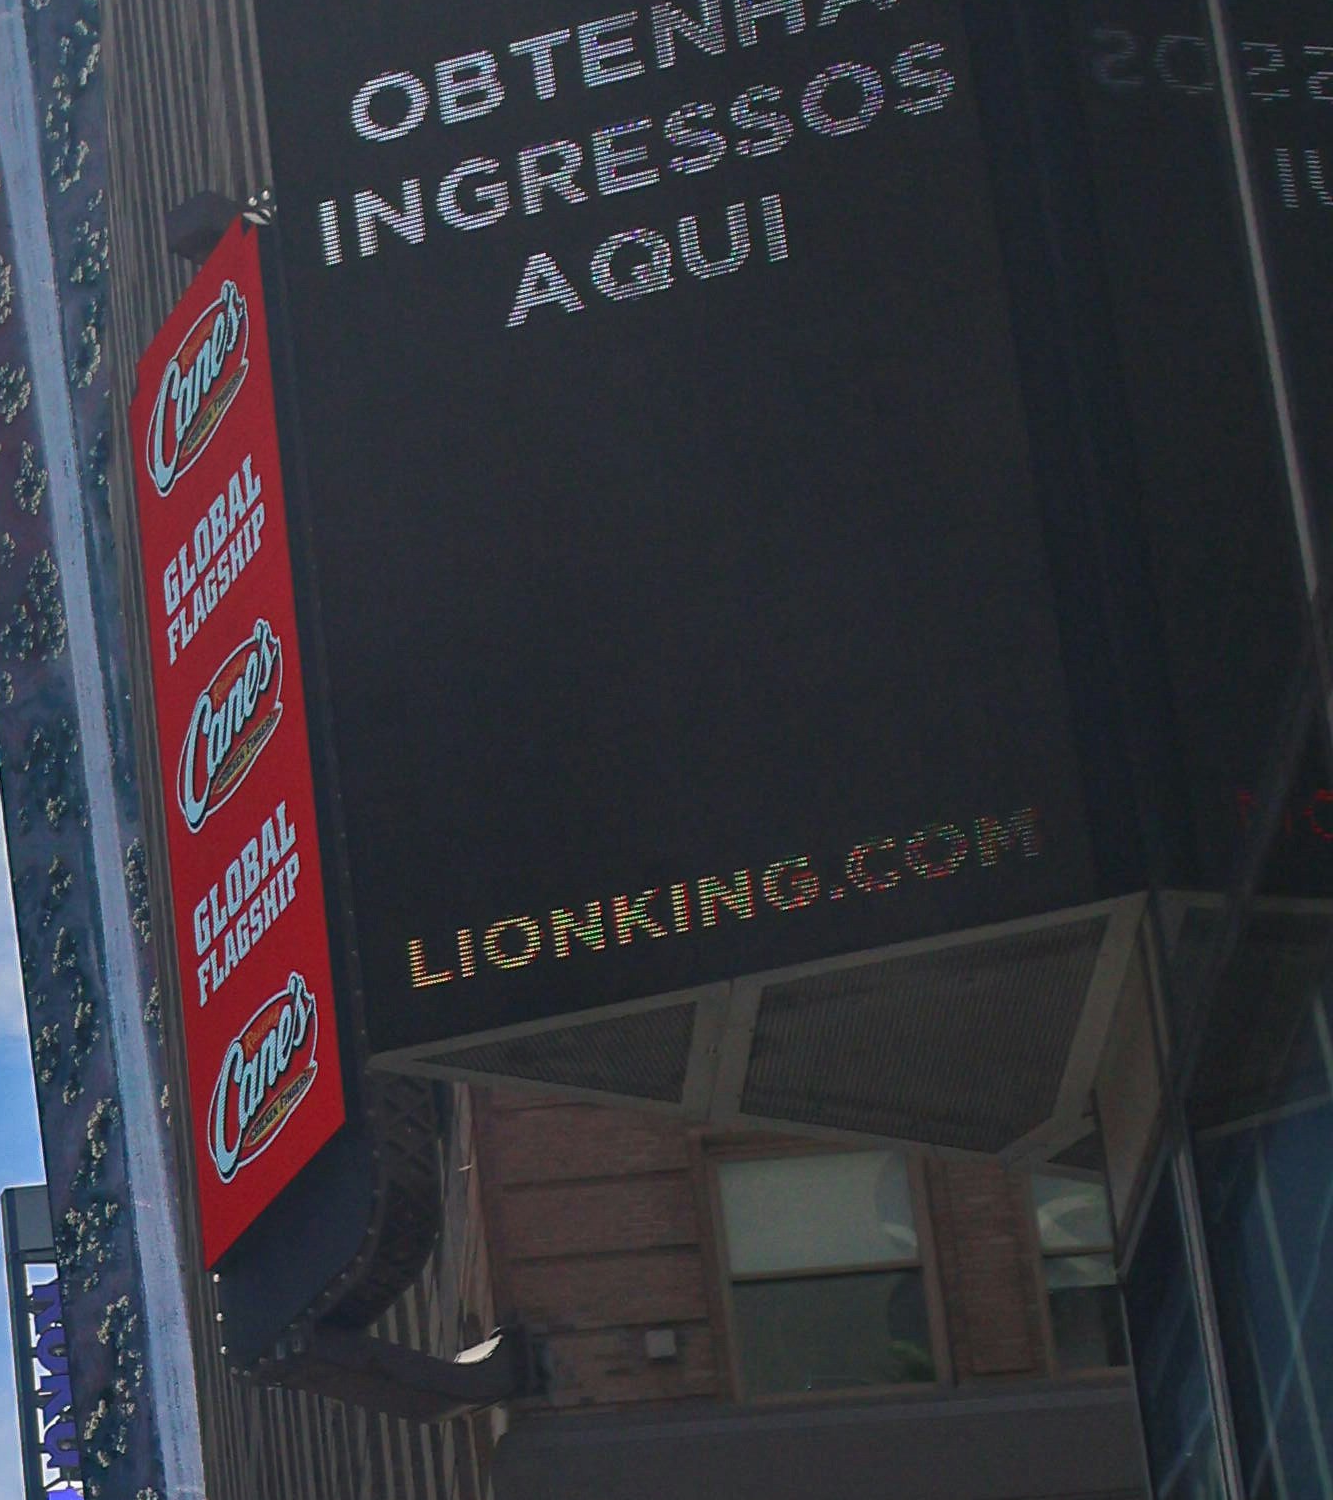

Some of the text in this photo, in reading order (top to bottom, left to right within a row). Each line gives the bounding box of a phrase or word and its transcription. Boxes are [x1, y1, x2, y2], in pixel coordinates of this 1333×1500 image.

[321, 40, 958, 266] INGRESSOS
[507, 196, 792, 327] AQUI
[155, 284, 244, 489] Cane's
[163, 453, 261, 615] GLOBAL
[167, 502, 266, 666] FLAGSHIP
[185, 621, 280, 825] Cane's
[194, 801, 296, 955] GLOBAL
[198, 851, 300, 1008] FLAGSHIP
[408, 808, 1046, 990] LIONKING.COM
[217, 975, 314, 1176] Cane's
